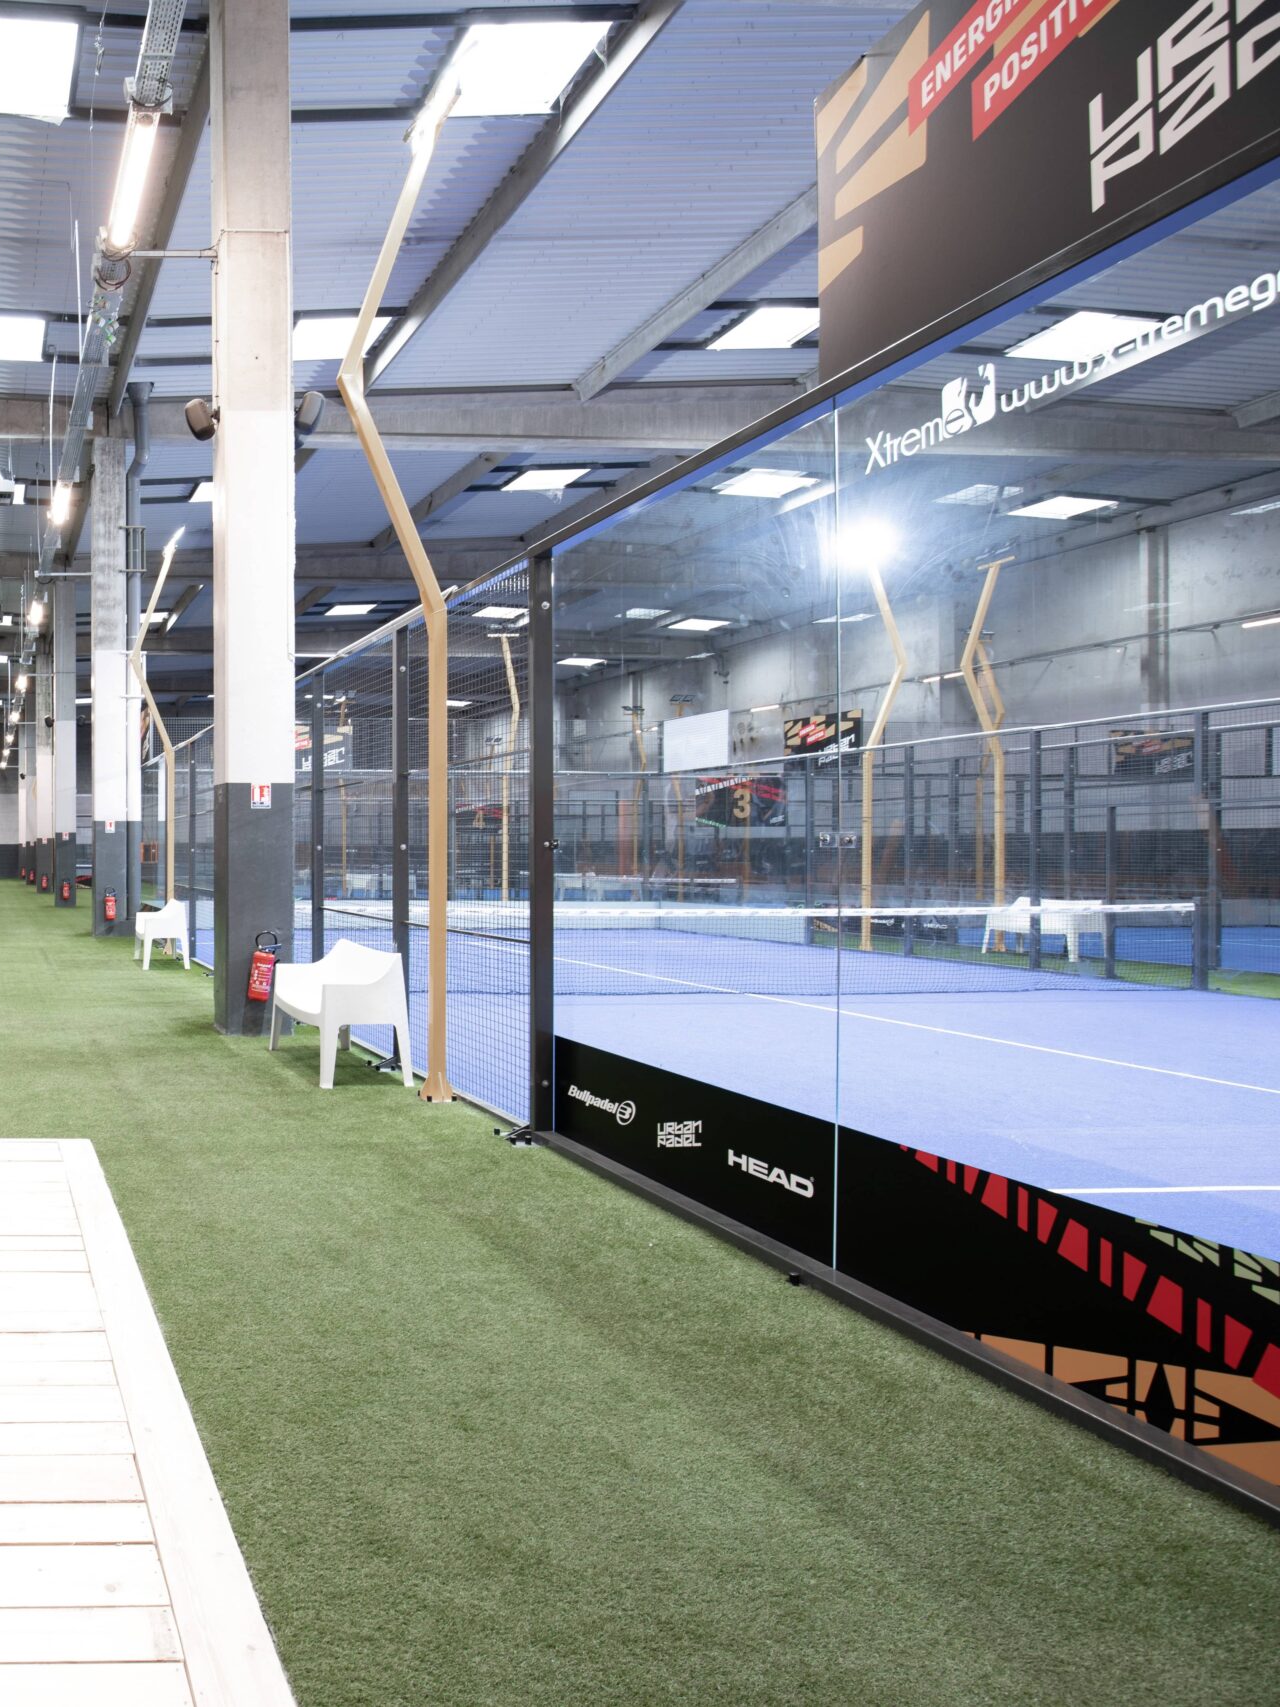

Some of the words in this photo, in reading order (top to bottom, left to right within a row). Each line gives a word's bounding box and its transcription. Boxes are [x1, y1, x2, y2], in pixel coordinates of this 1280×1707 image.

[983, 0, 1094, 112] POSITI
[865, 408, 966, 475] Xtreme
[733, 788, 751, 818] 3
[568, 1085, 619, 1114] Bullpadel
[728, 1149, 814, 1198] HEAD
